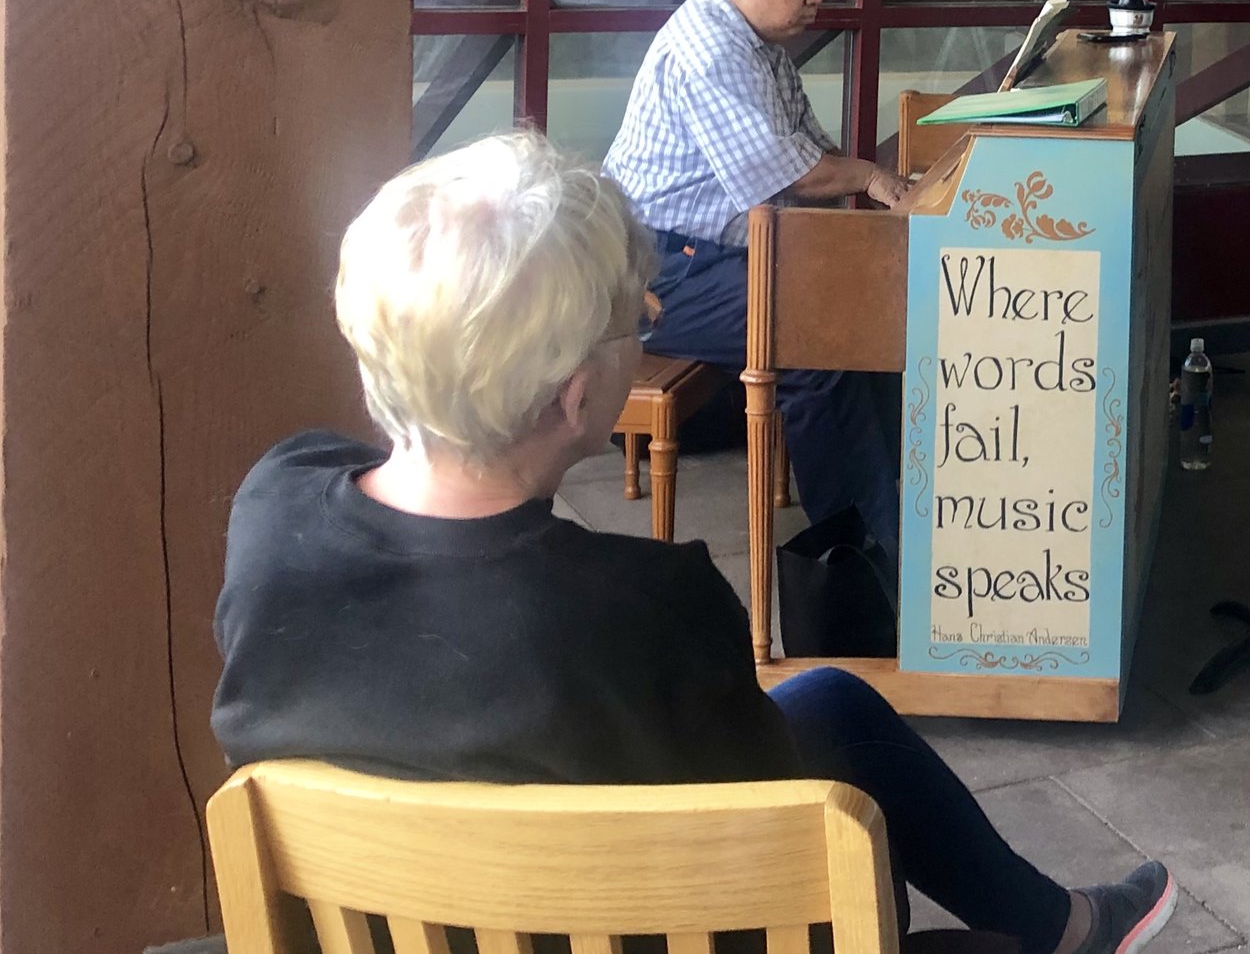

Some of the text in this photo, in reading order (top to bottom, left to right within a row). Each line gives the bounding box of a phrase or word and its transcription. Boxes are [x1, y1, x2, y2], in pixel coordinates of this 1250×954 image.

[941, 254, 1094, 324] Where
[939, 330, 1097, 393] words
[937, 402, 1030, 468] fail,
[935, 489, 1089, 532] music
[934, 549, 1090, 618] speaks
[932, 622, 1088, 646] Hans Christian Andersen
